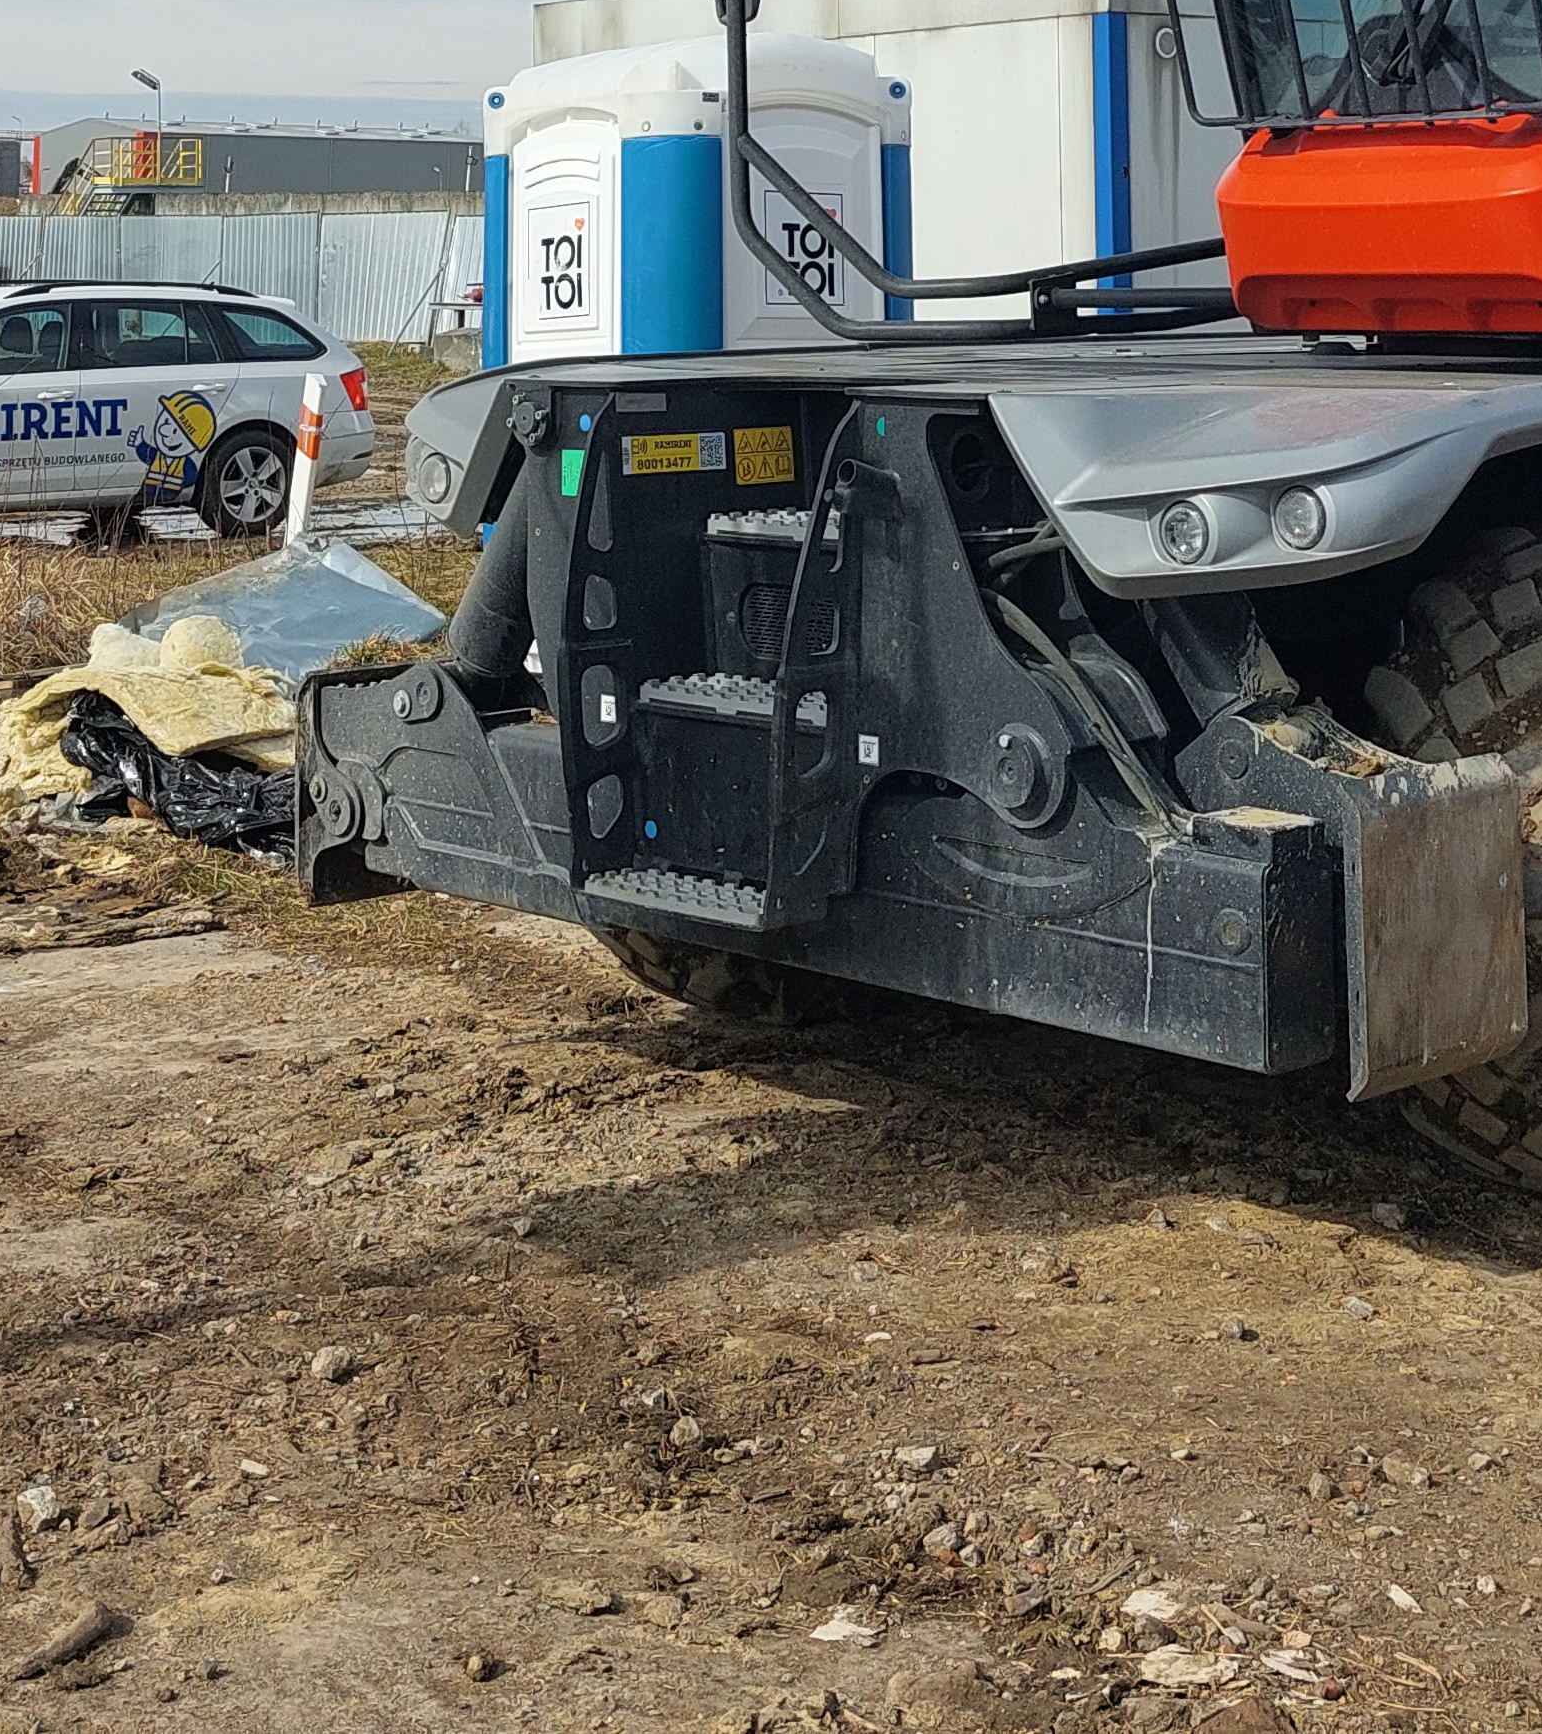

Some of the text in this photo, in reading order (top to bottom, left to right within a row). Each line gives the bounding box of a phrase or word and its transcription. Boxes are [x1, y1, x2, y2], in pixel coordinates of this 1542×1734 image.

[541, 272, 583, 310] TOI
[44, 452, 127, 466] BUDOWLANEGO
[637, 456, 692, 471] 80013477
